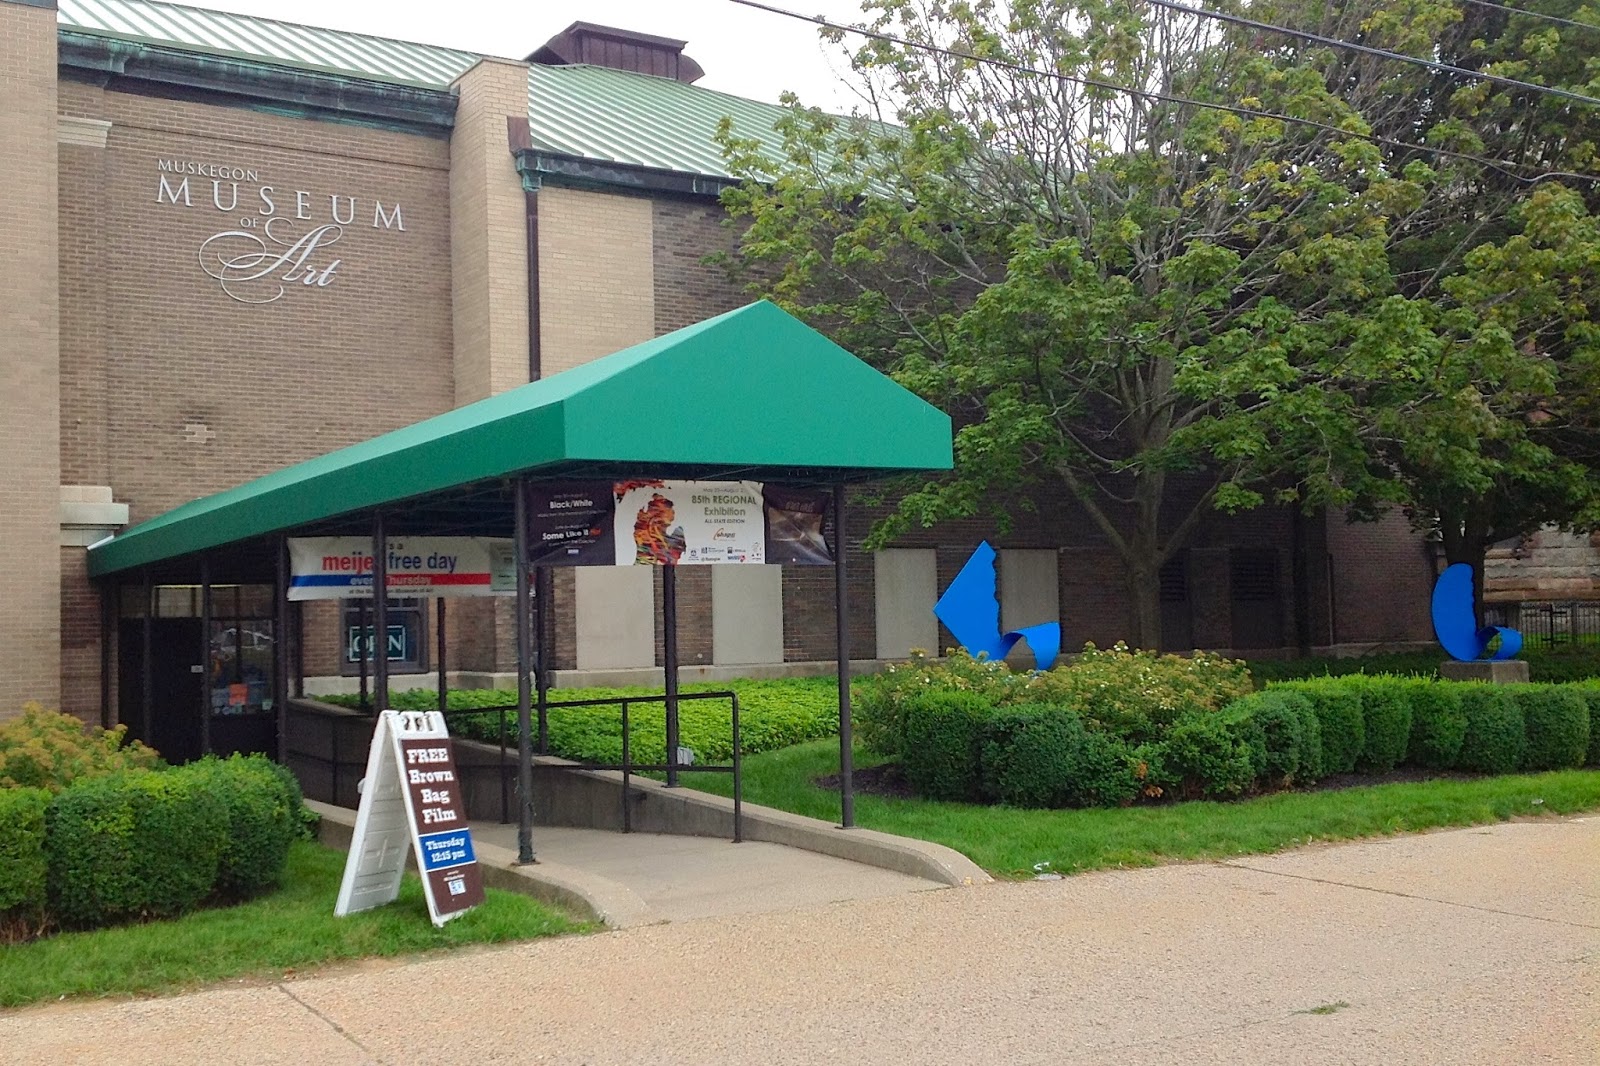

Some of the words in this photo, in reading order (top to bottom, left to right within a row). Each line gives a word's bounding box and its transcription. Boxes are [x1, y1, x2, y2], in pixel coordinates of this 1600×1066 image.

[157, 158, 259, 182] MUSKEGON
[155, 174, 407, 232] MUSEUM
[239, 217, 259, 228] OF
[198, 216, 343, 304] Art
[549, 499, 593, 509] Black/White
[691, 495, 711, 504] 85th
[712, 495, 757, 505] REGIONAL
[704, 506, 746, 516] Exhibition
[542, 532, 565, 540] Some
[322, 551, 374, 575] meije
[388, 552, 422, 570] free
[427, 552, 457, 574] day
[350, 577, 374, 586] ever
[406, 748, 449, 764] FREE
[408, 769, 454, 784] Brown
[420, 788, 450, 804] Bag
[422, 807, 457, 824] Film
[425, 837, 465, 851] Thursday
[431, 850, 451, 862] 12:15
[452, 850, 466, 860] pm
